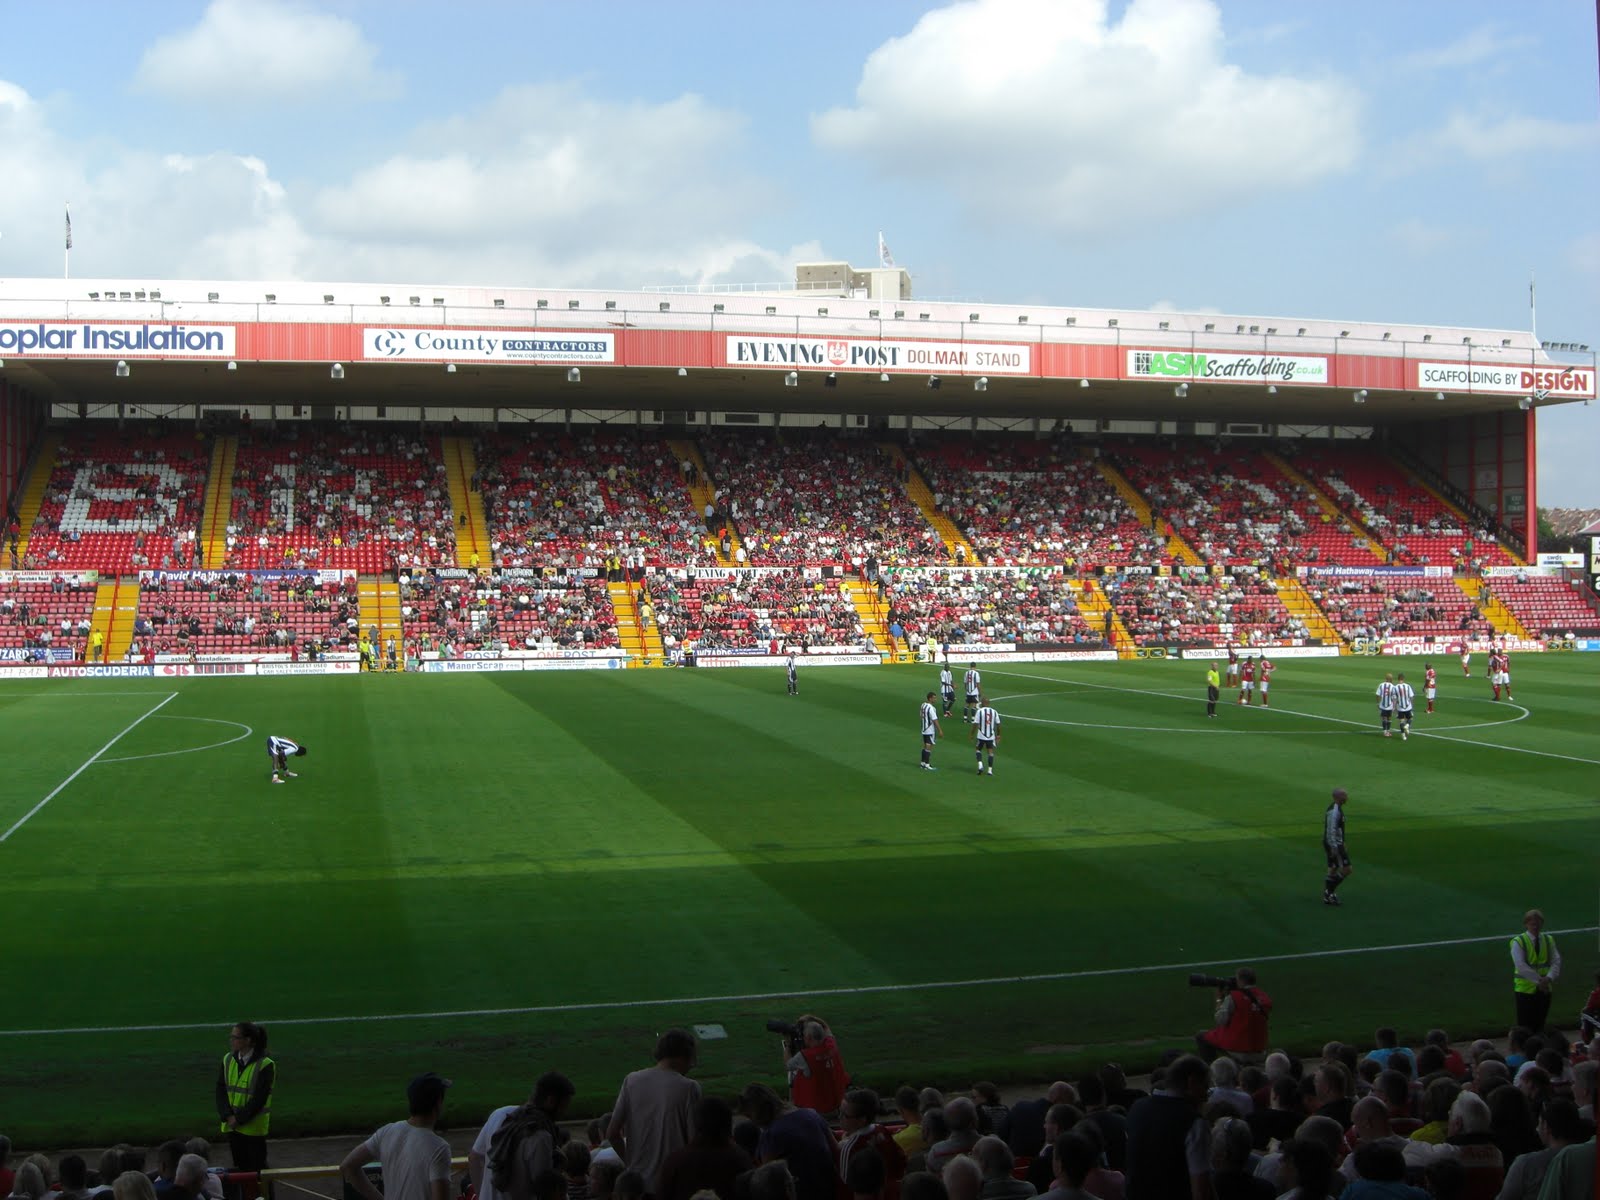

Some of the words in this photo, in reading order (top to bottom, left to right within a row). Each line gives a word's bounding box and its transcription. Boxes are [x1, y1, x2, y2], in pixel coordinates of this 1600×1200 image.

[0, 324, 77, 354] oplar
[83, 324, 224, 351] Insulation
[414, 331, 498, 355] County
[504, 340, 606, 352] CONTRACTORS
[506, 352, 603, 360] www.countycontractors.co.uk
[736, 341, 824, 365] EVENING
[851, 344, 900, 366] POST
[907, 349, 968, 365] DOLMAN
[975, 351, 1021, 368] STAND
[1151, 353, 1207, 376] ASM
[1424, 369, 1501, 385] SCAFFOLDING
[1505, 373, 1518, 385] BY
[1520, 371, 1588, 391] DESIGN
[159, 570, 190, 580] David
[192, 570, 246, 581] Hathway
[698, 569, 726, 578] ENING
[735, 569, 758, 578] POT
[1311, 567, 1333, 575] David
[1335, 567, 1375, 576] Hathaway
[0, 648, 35, 660] ZARD
[1393, 643, 1451, 655] npower
[52, 665, 151, 677] AUTOSCUDERIA
